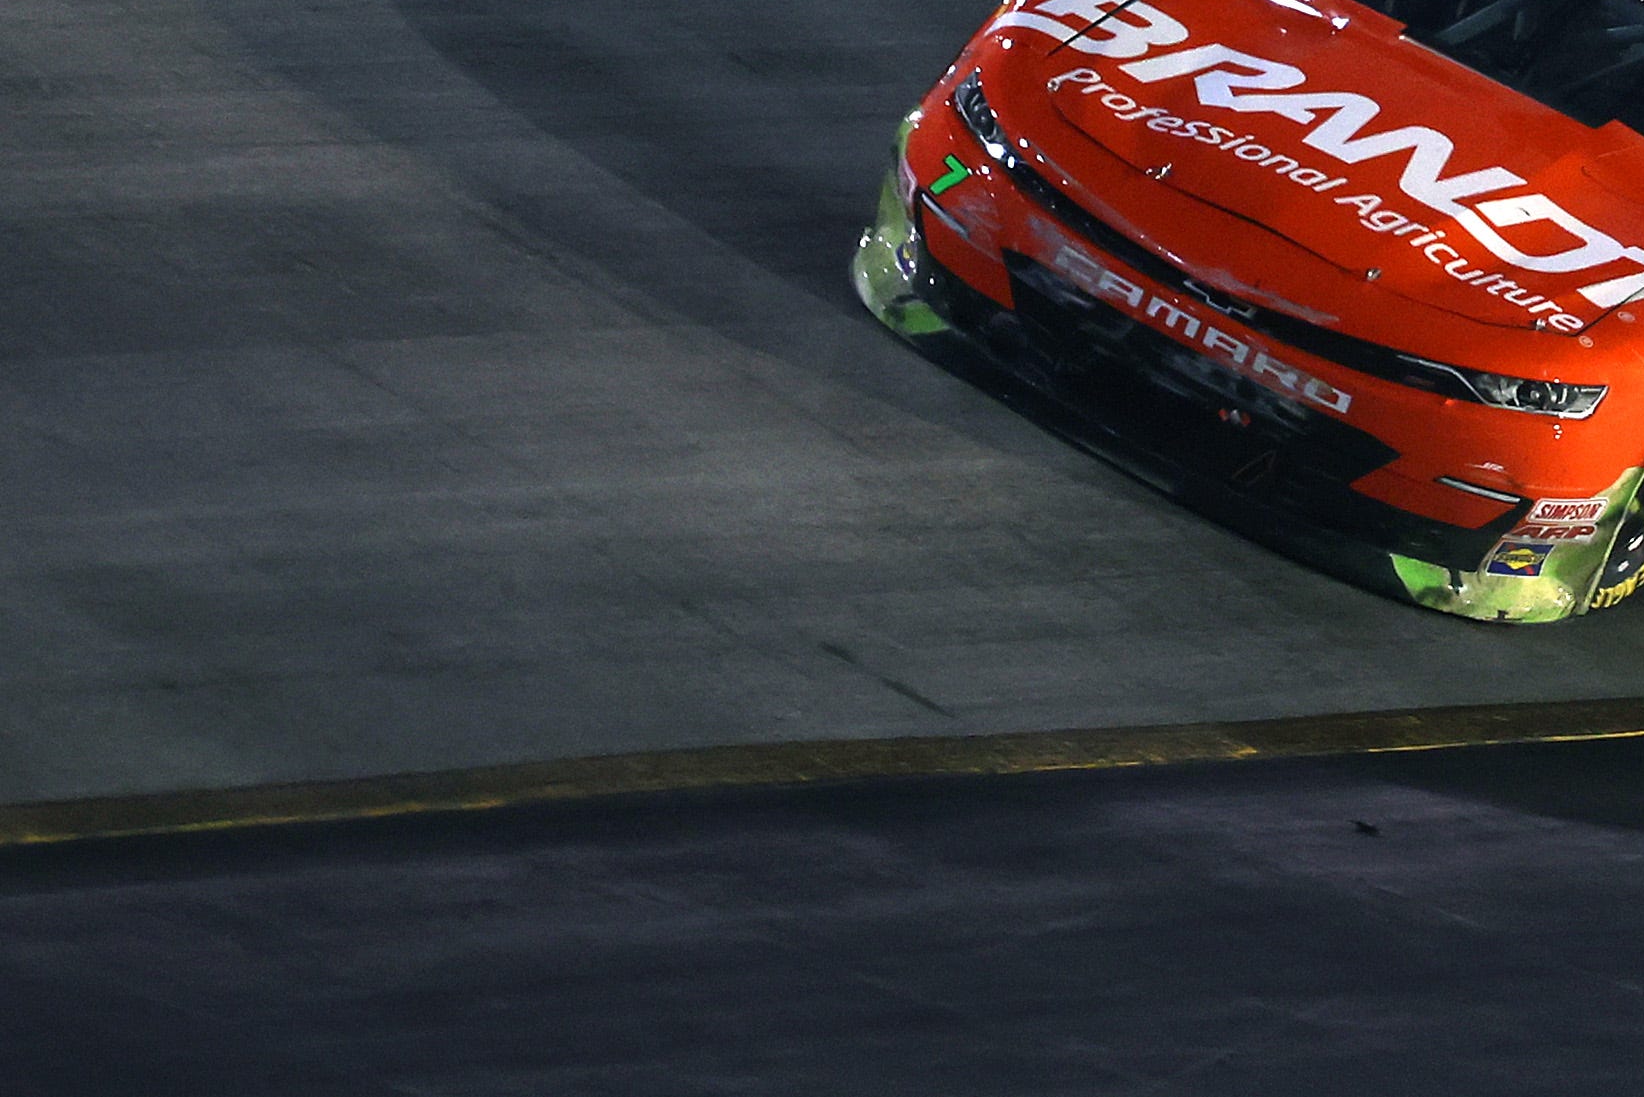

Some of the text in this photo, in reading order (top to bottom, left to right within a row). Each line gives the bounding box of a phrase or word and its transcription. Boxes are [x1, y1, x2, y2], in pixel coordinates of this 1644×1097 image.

[928, 154, 971, 195] 7
[1050, 67, 1585, 333] Professional Agriculture
[1055, 245, 1352, 415] CAMARO
[1535, 503, 1603, 520] SIMPSON
